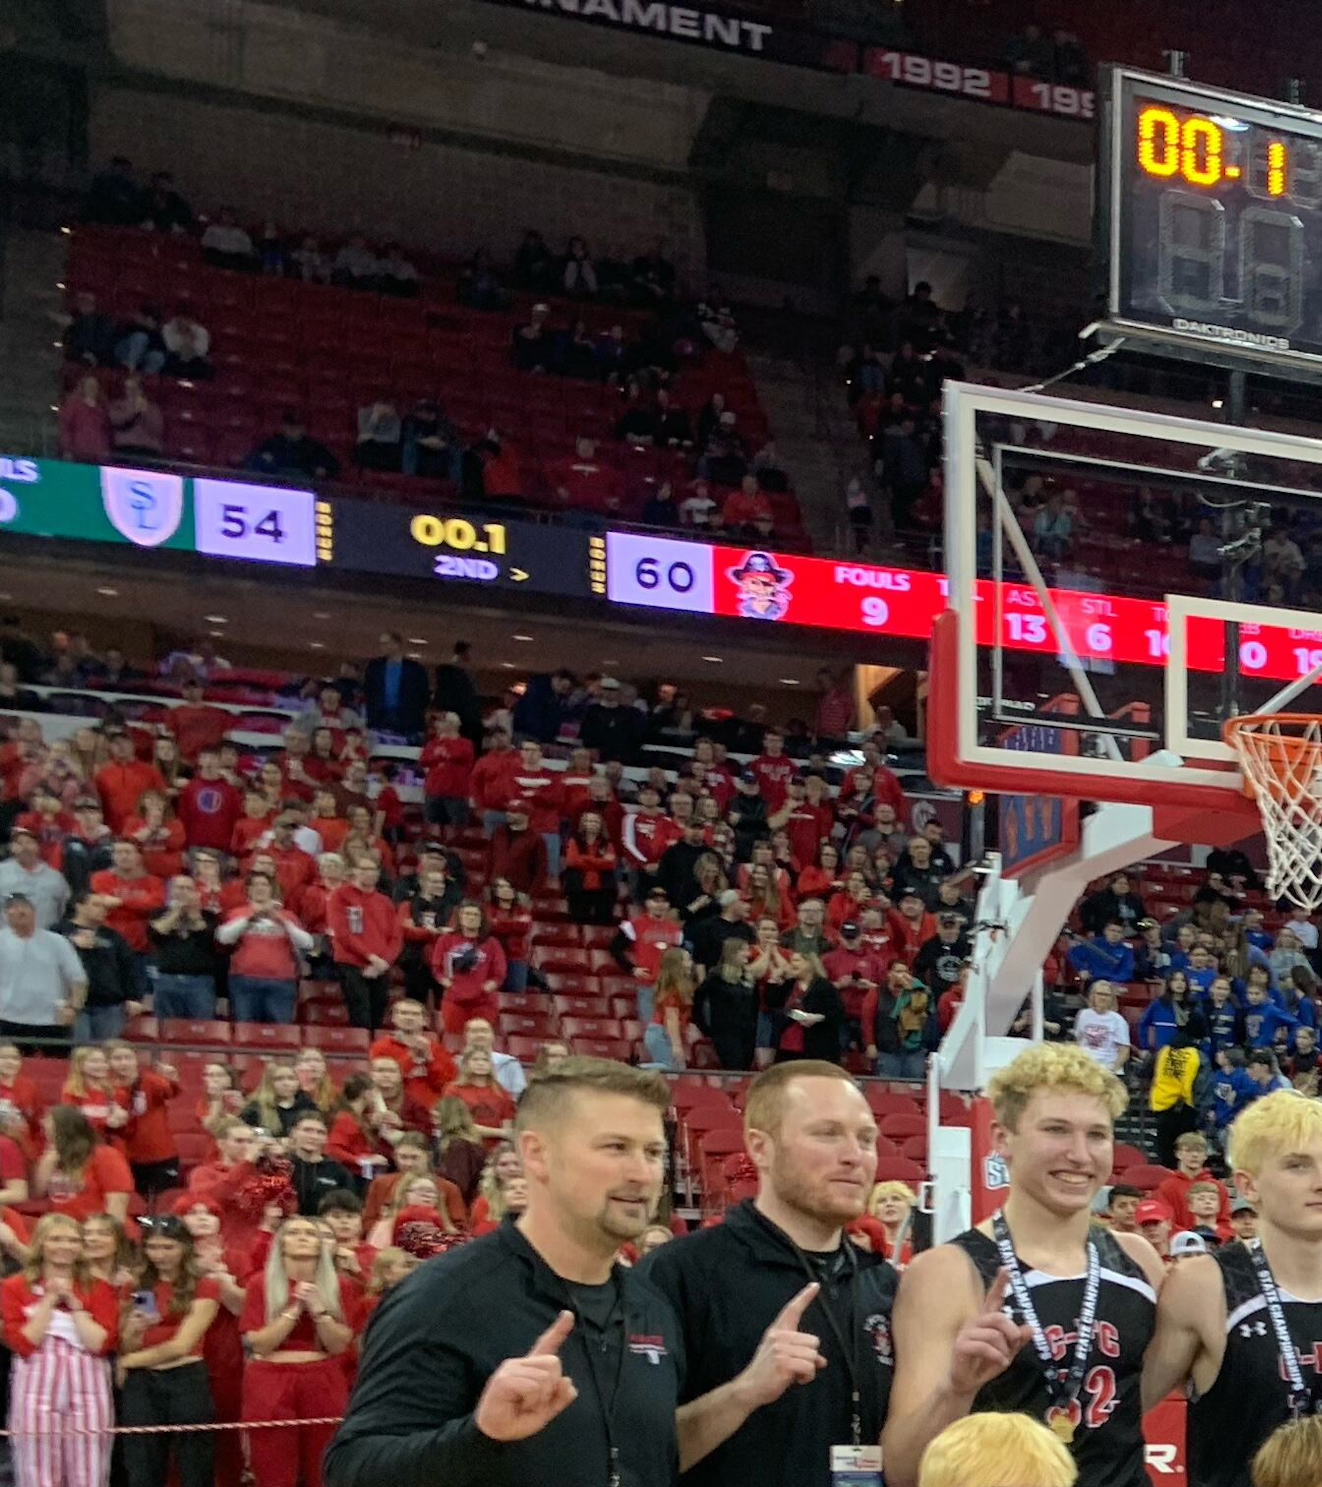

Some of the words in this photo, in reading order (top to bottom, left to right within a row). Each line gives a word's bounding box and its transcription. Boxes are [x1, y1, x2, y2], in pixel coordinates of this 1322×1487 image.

[881, 52, 992, 97] 1992
[1172, 318, 1290, 350] DAKTRONICS
[220, 503, 286, 544] 54
[410, 513, 508, 555] 00.1
[433, 554, 499, 581] 2ND
[635, 556, 694, 594] 60
[834, 565, 911, 592] FOULS
[860, 597, 889, 626] 9
[1080, 598, 1119, 617] STL
[1005, 612, 1047, 643] 13
[1086, 623, 1113, 652] 6
